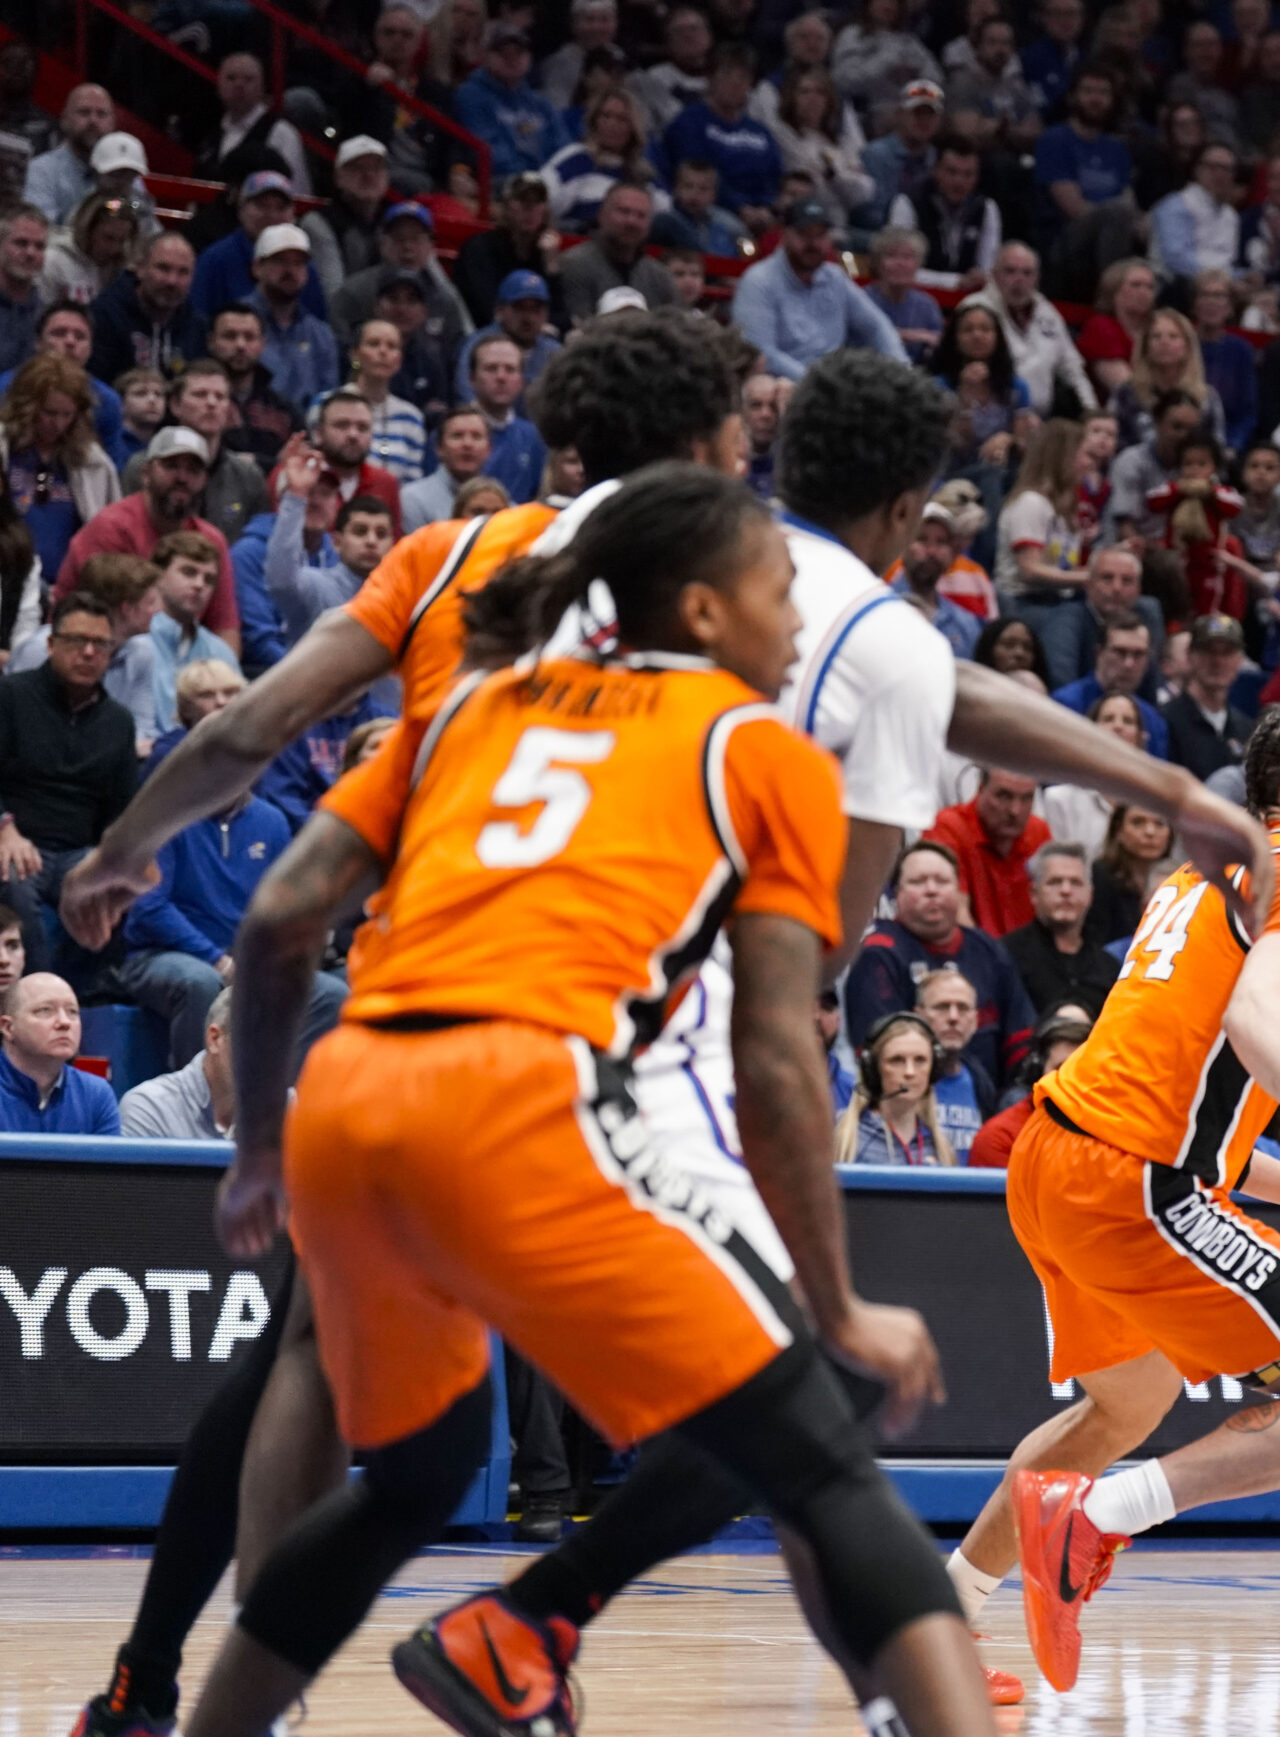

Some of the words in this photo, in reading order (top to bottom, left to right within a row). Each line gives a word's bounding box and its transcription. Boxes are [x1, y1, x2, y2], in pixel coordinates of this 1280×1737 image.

[474, 723, 619, 870] 5
[1117, 880, 1210, 982] 24
[1164, 1192, 1278, 1291] COWBOYS
